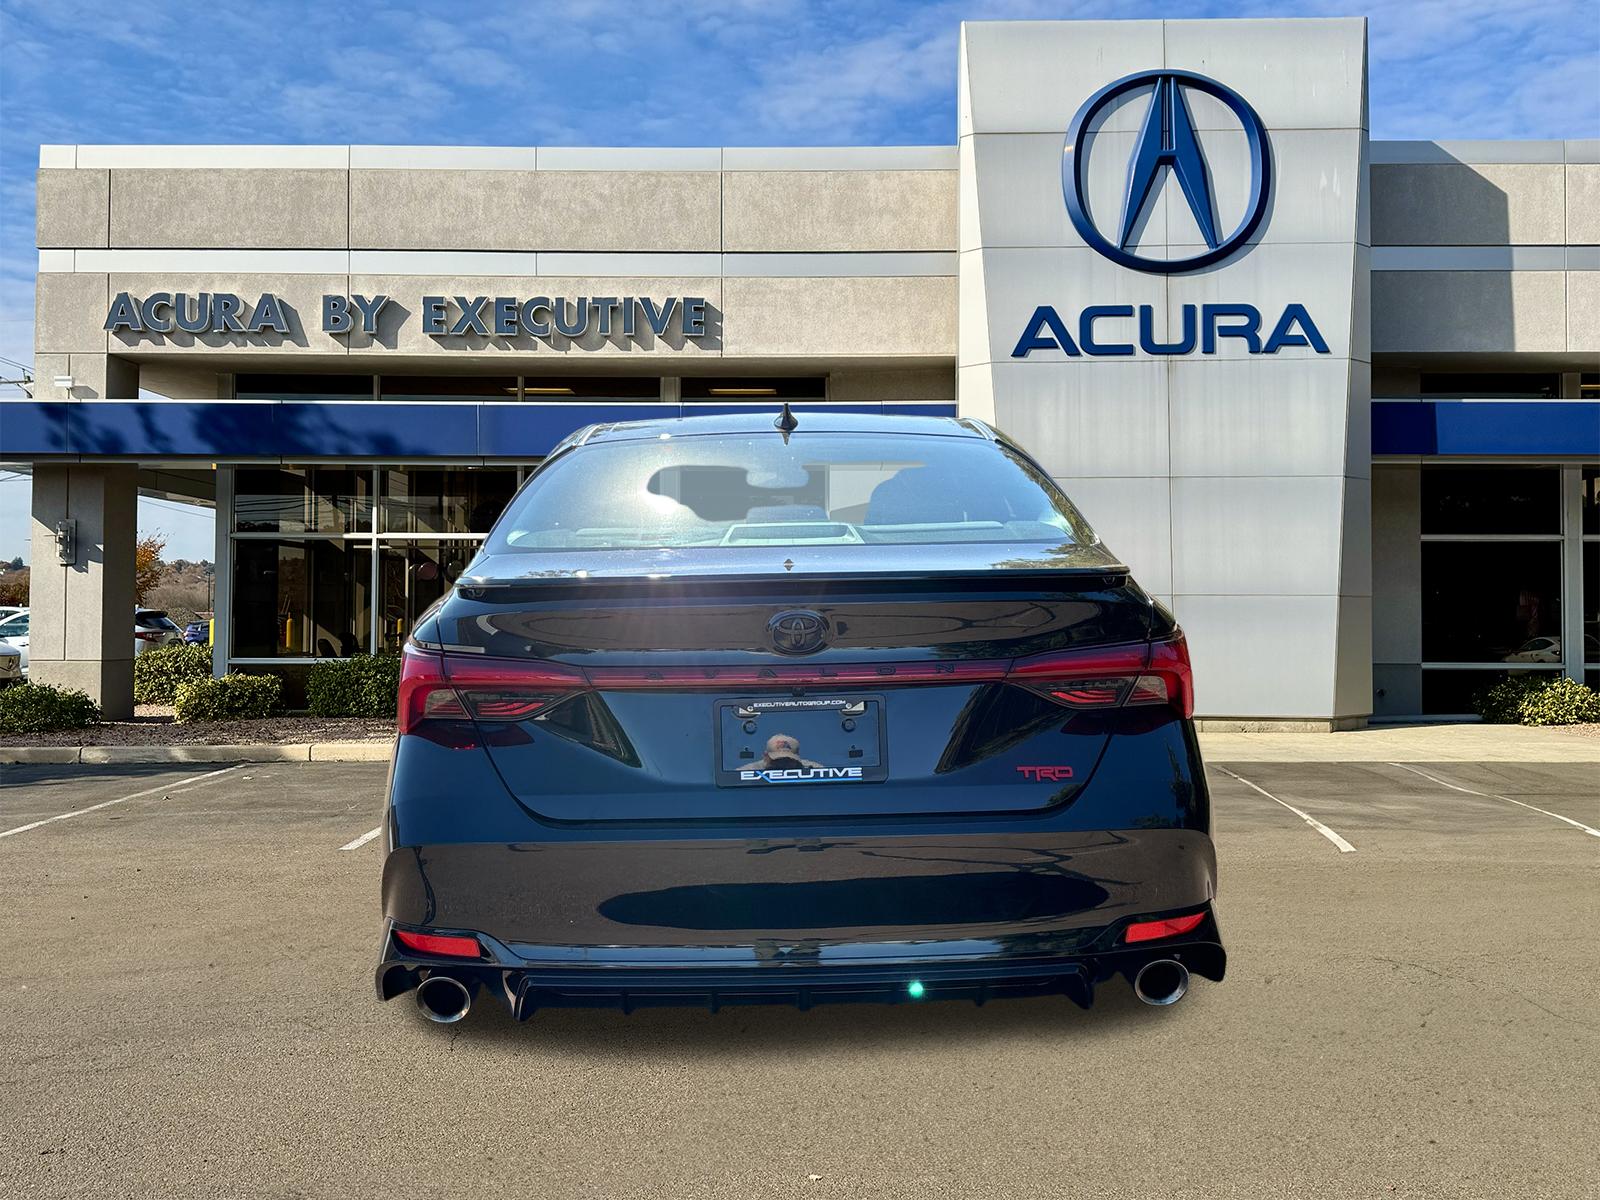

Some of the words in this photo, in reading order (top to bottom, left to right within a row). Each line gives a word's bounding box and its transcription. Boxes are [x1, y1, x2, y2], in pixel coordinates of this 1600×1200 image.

[103, 292, 290, 333] ACURA
[322, 294, 391, 335] BY
[422, 296, 706, 337] EXECUTIVE
[1011, 303, 1333, 357] ACURA
[753, 700, 846, 708] EXECUTIVEAUTOGROUP.COM
[740, 767, 863, 783] EXECUTIVE
[1016, 766, 1073, 782] TRD
